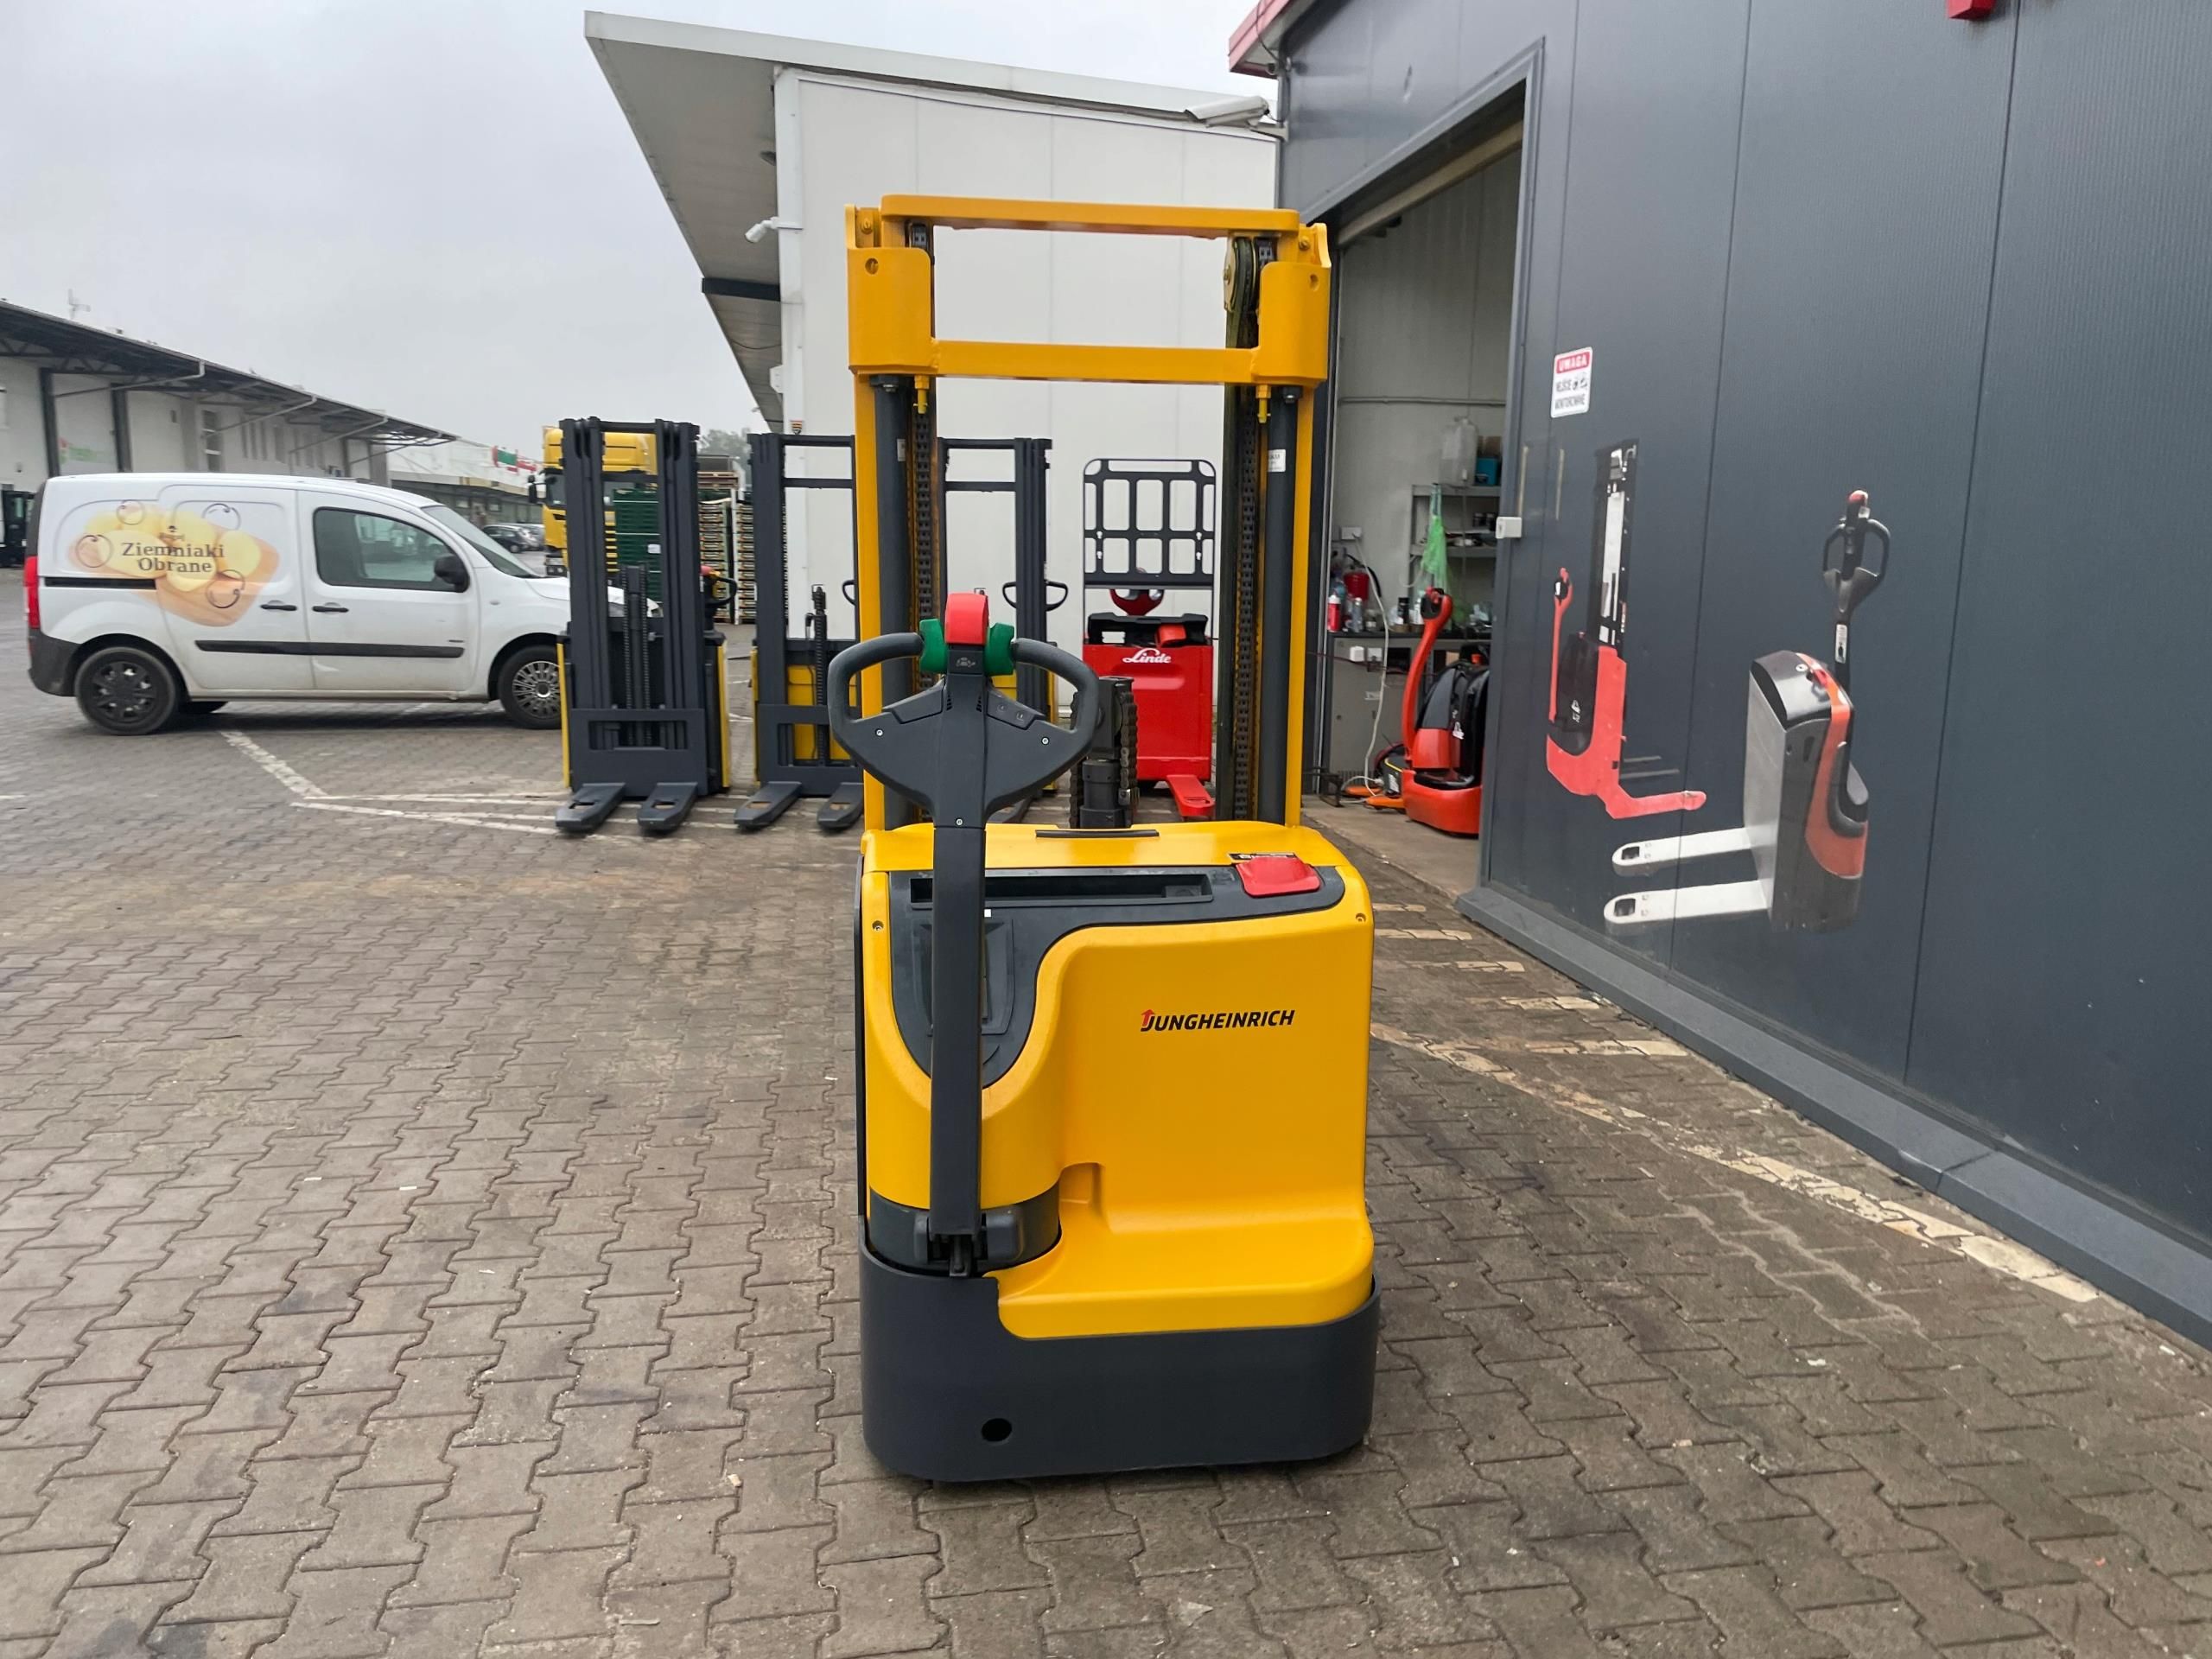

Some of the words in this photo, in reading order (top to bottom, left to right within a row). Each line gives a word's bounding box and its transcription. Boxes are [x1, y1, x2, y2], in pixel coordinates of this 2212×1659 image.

[1558, 354, 1588, 372] UWAGA
[122, 543, 225, 558] Ziemniaki
[137, 557, 213, 572] Obrane
[1122, 648, 1172, 664] Linde
[1141, 1009, 1295, 1033] JUNGHEINRICH
